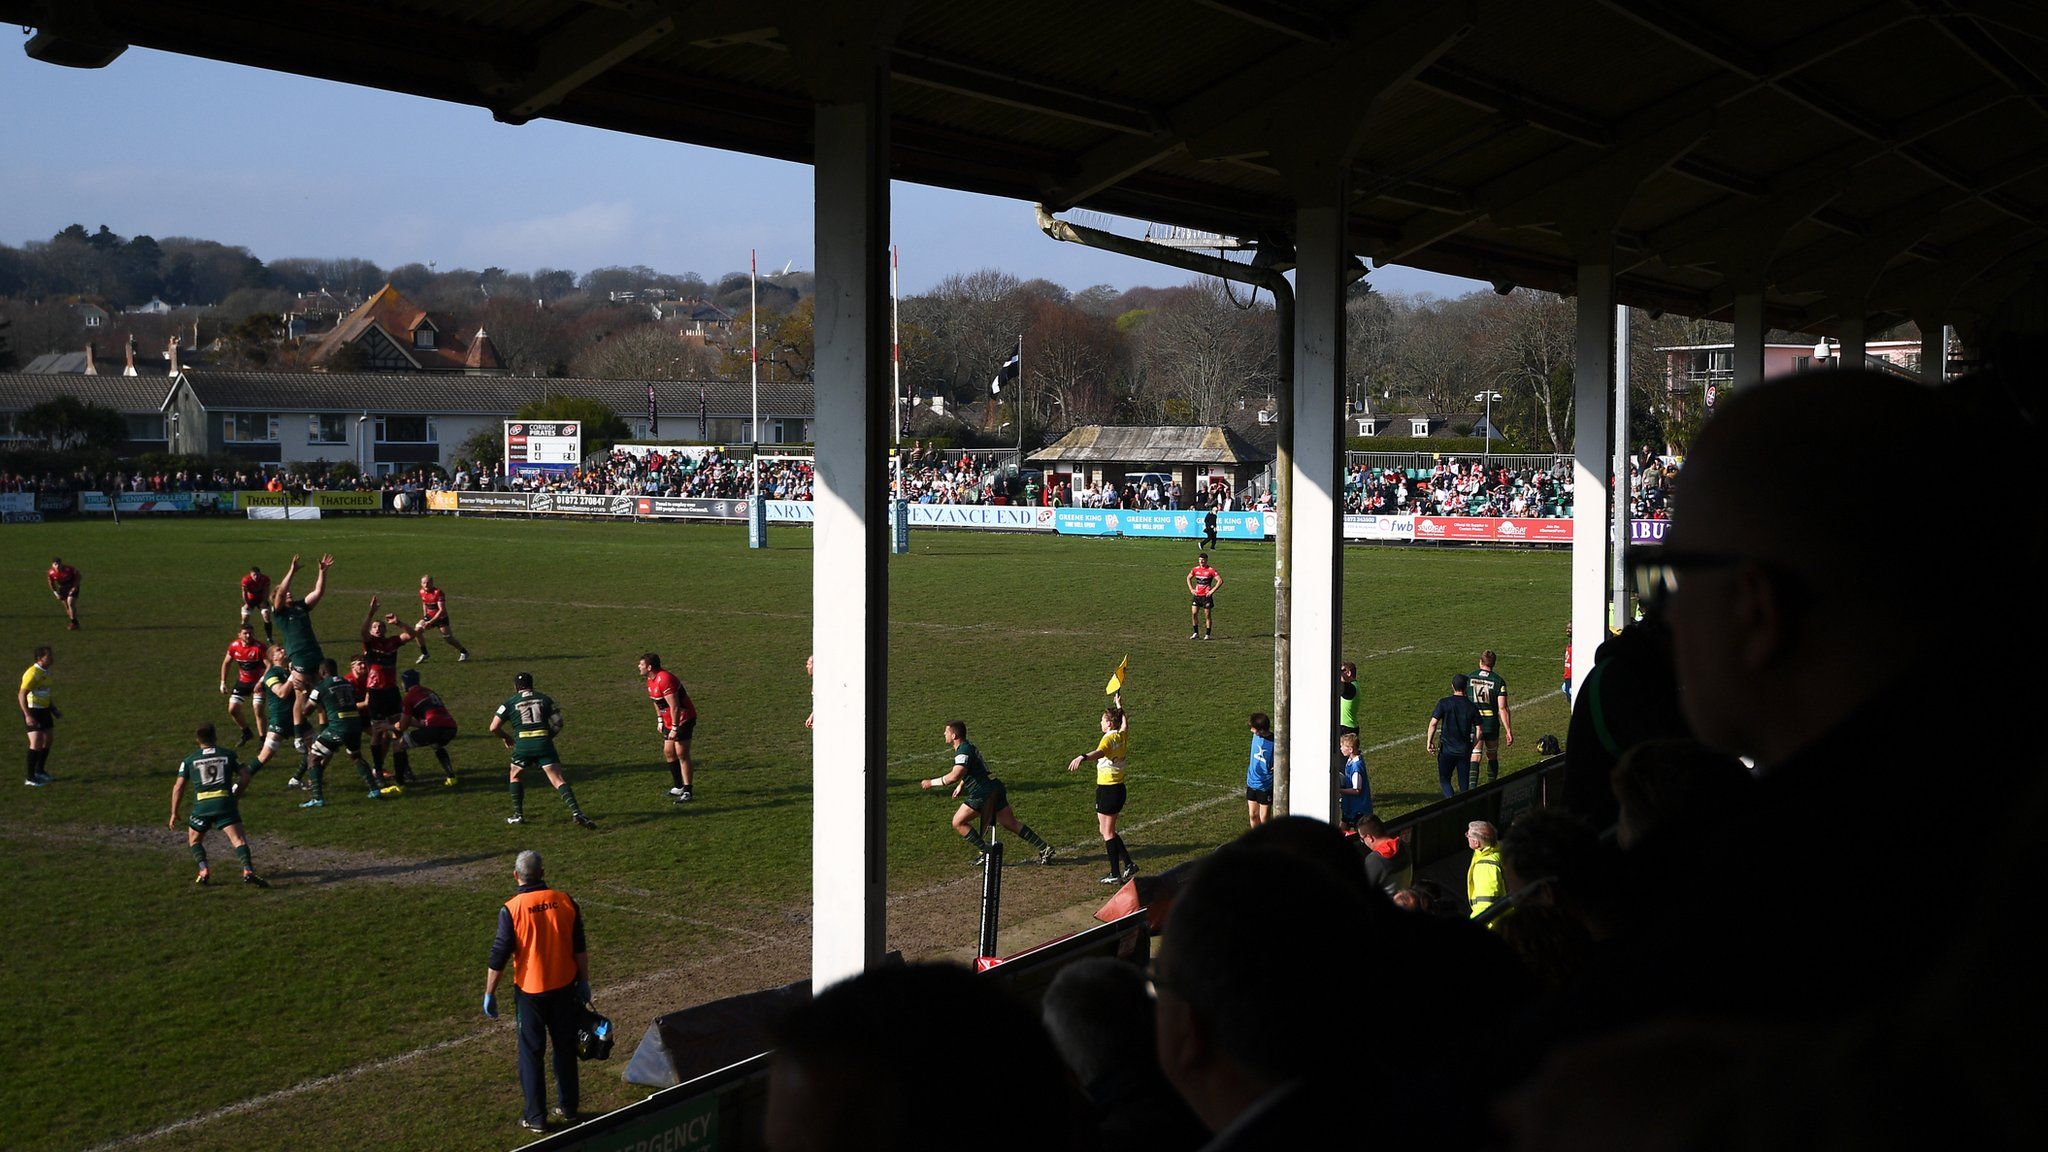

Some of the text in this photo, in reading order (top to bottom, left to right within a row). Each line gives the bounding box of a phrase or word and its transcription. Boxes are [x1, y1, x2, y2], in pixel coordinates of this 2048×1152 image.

[247, 495, 302, 506] THATCHERS
[320, 495, 375, 506] THATCHERS
[557, 496, 579, 504] 01872
[580, 497, 606, 506] 270847
[908, 508, 1030, 524] ENZANCE END
[1106, 514, 1119, 527] IPA
[1153, 516, 1171, 524] KING
[1174, 514, 1188, 527] IPA
[1224, 517, 1242, 525] KING
[1245, 516, 1260, 528] IPA
[1391, 520, 1413, 532] fwb
[207, 765, 218, 783] 9
[528, 901, 560, 914] MEDIC
[616, 1112, 712, 1152] ERGENCY
